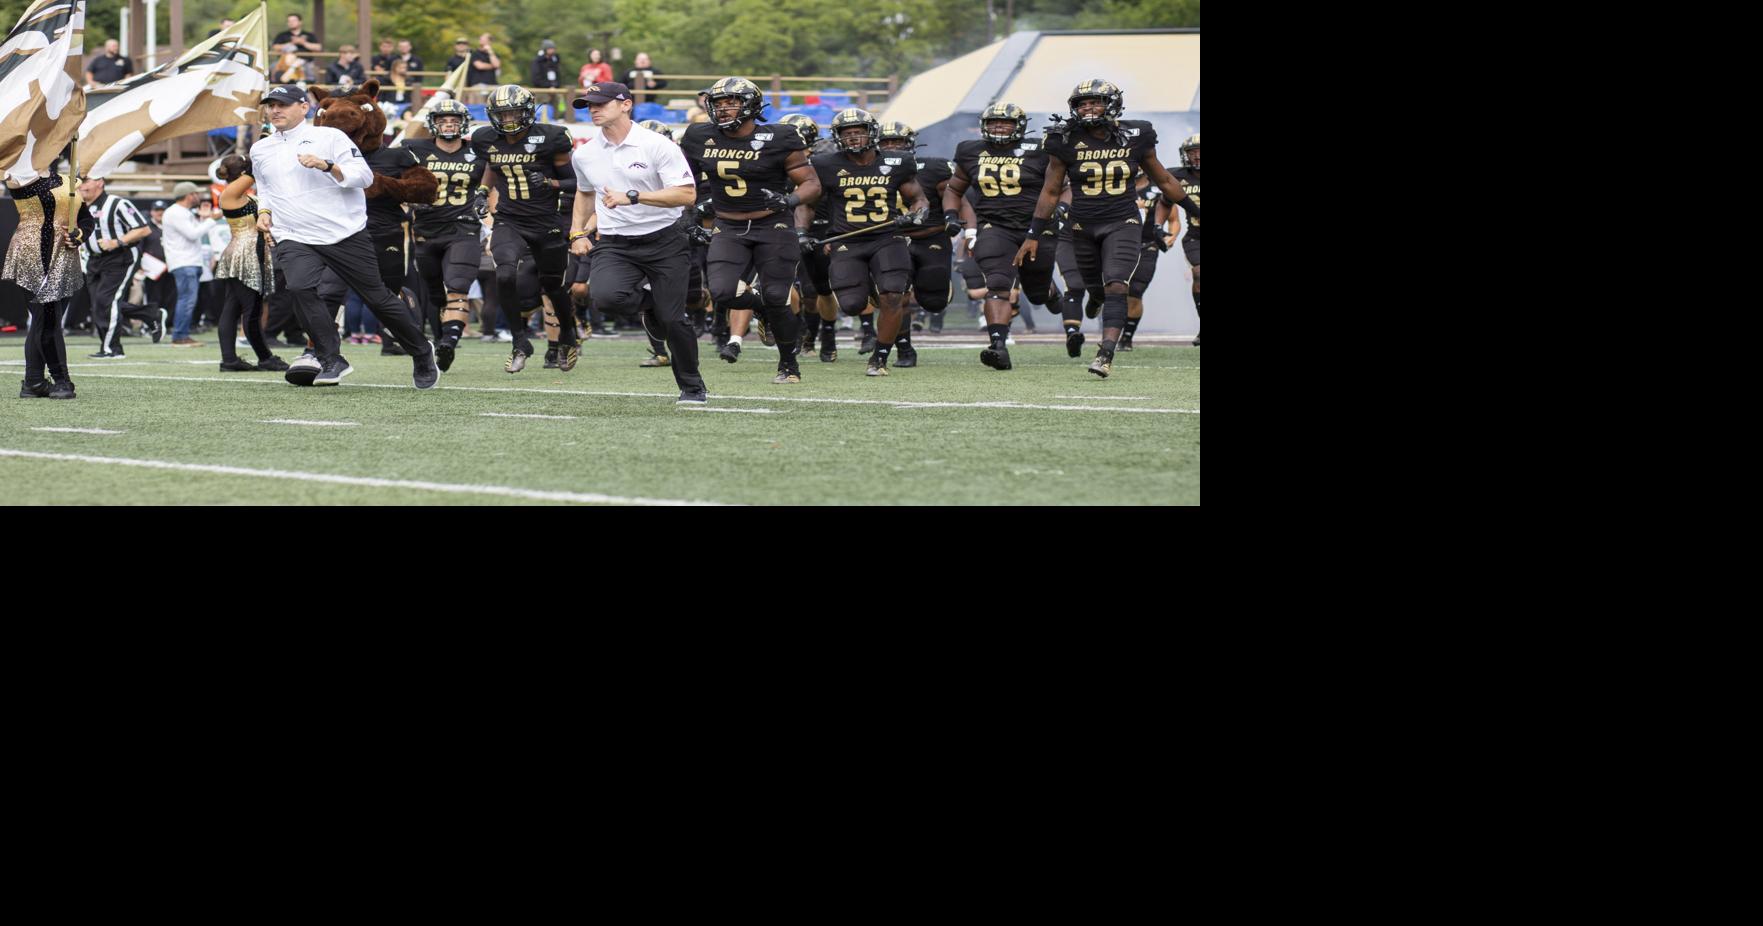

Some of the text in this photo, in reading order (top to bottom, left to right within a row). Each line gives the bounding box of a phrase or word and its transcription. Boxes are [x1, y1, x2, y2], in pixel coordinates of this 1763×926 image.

[490, 153, 536, 163] BRONCOS
[703, 148, 761, 160] BRONCOS
[1077, 147, 1131, 161] BRONCOS
[427, 161, 475, 172] BRONCOS
[1079, 160, 1130, 196] 30
[500, 164, 530, 200] 11
[717, 161, 747, 197] 5
[839, 175, 891, 187] BRONCOS
[978, 163, 1022, 197] 68
[843, 187, 889, 222] 23
